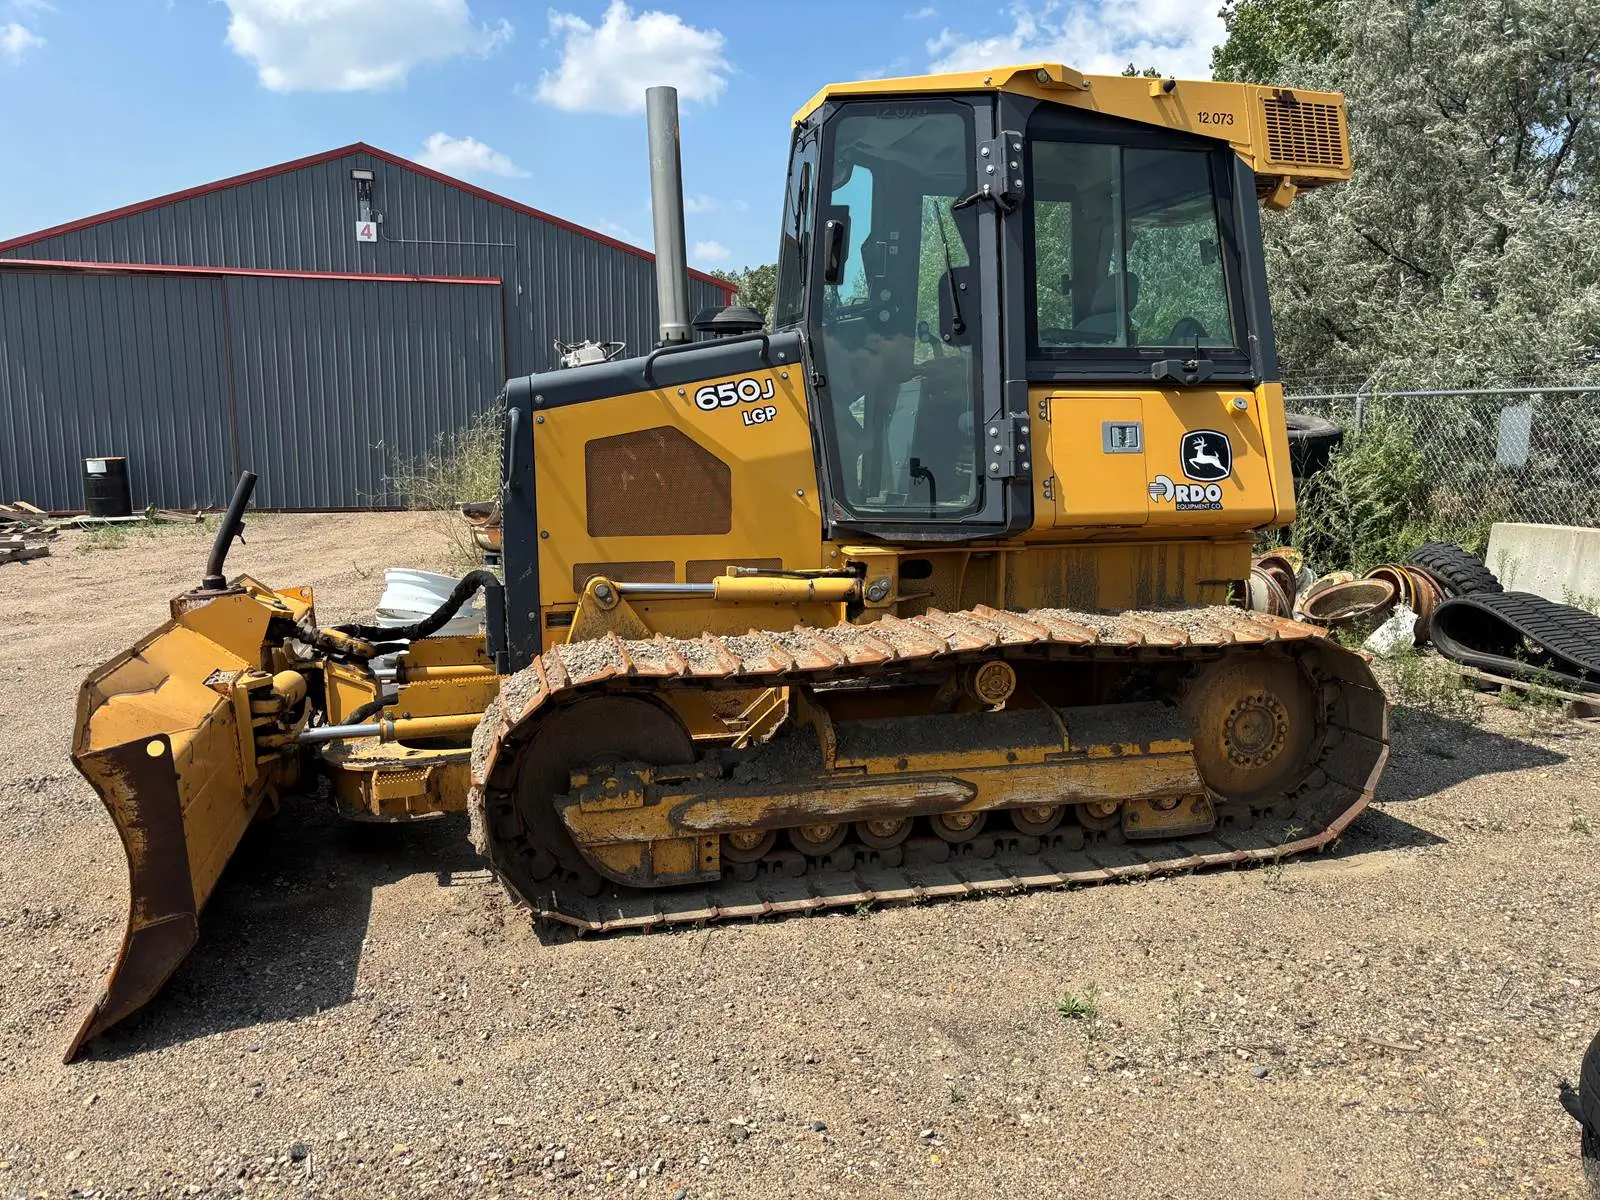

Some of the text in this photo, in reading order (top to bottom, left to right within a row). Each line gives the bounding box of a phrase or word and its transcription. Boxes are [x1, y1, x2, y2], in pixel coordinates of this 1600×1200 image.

[1197, 111, 1234, 125] 12.073
[360, 223, 373, 239] 4
[695, 378, 775, 411] 650J
[742, 406, 777, 426] LGP
